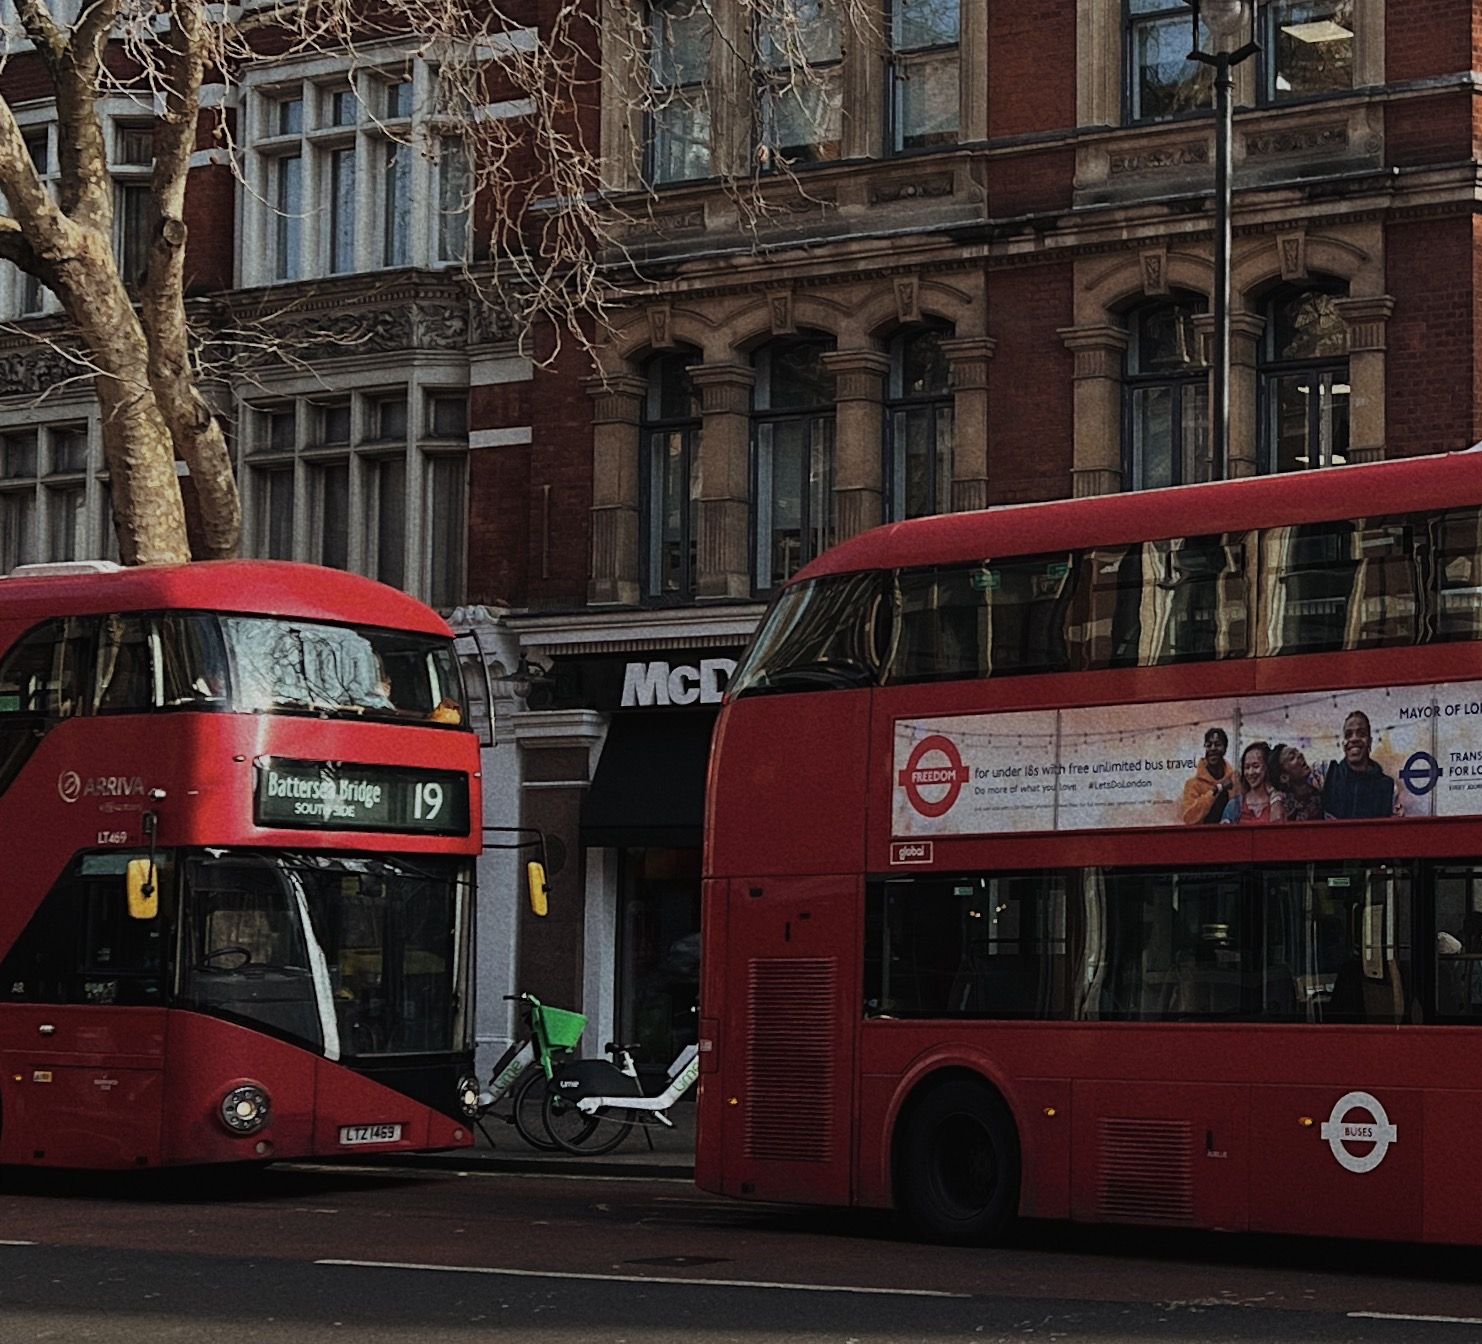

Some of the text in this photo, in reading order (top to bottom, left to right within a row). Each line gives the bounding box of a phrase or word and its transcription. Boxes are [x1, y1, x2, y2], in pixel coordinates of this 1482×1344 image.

[1399, 705, 1441, 720] MAYOR
[1444, 703, 1461, 717] OF
[911, 769, 957, 784] FREEDOM
[975, 767, 989, 779] for
[992, 765, 1022, 778] under
[1041, 763, 1066, 776] with
[1069, 761, 1090, 775] free
[1092, 760, 1142, 774] unlimited
[1145, 759, 1164, 771] bus
[1166, 757, 1198, 770] travel
[1449, 765, 1469, 777] FOR
[83, 776, 145, 797] ARRIVA
[339, 778, 382, 809] Bridge
[414, 782, 444, 820] 19
[1344, 1127, 1373, 1138] BUSES
